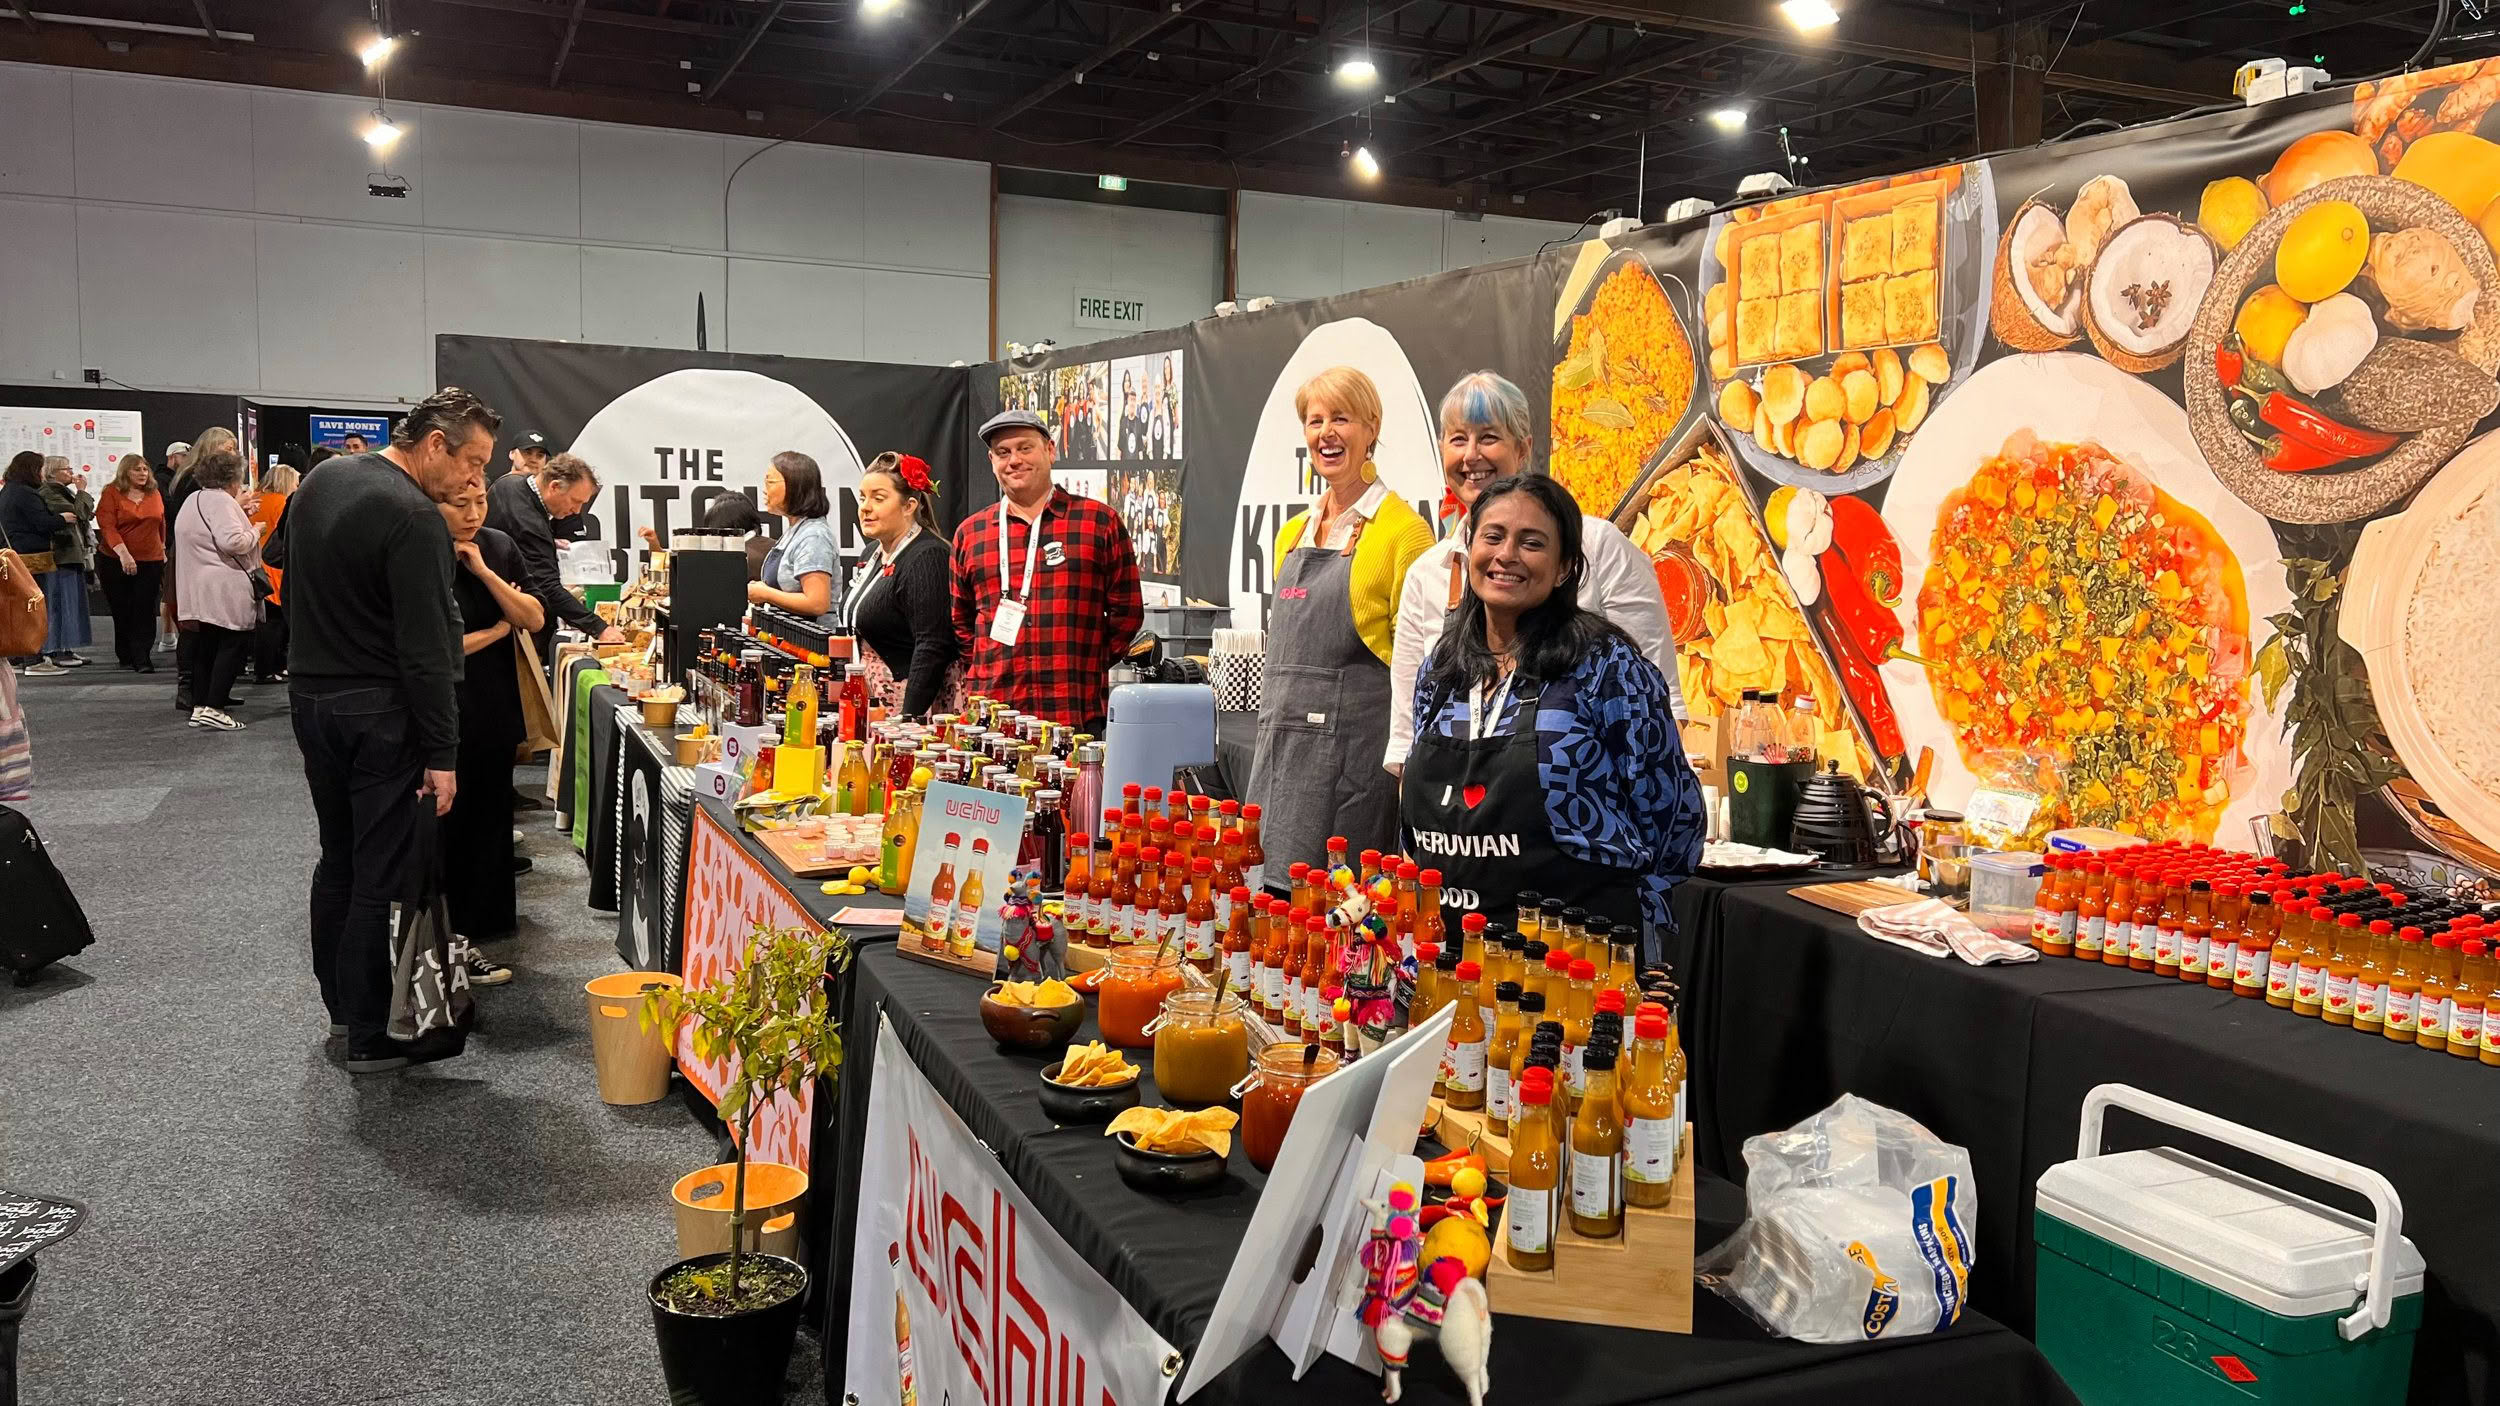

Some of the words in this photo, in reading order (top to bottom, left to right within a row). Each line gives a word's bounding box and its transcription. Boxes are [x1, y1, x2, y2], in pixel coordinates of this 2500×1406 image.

[1080, 298, 1110, 319] FIRE
[1114, 301, 1143, 321] EXIT
[319, 422, 343, 430] SAVE
[345, 423, 381, 431] MONEY
[654, 447, 723, 481] THE
[1441, 785, 1452, 806] I
[945, 800, 1001, 825] uchu
[1412, 827, 1520, 858] PERUVIAN
[1440, 887, 1480, 910] OOD
[1918, 1223, 1943, 1270] NAPKINS
